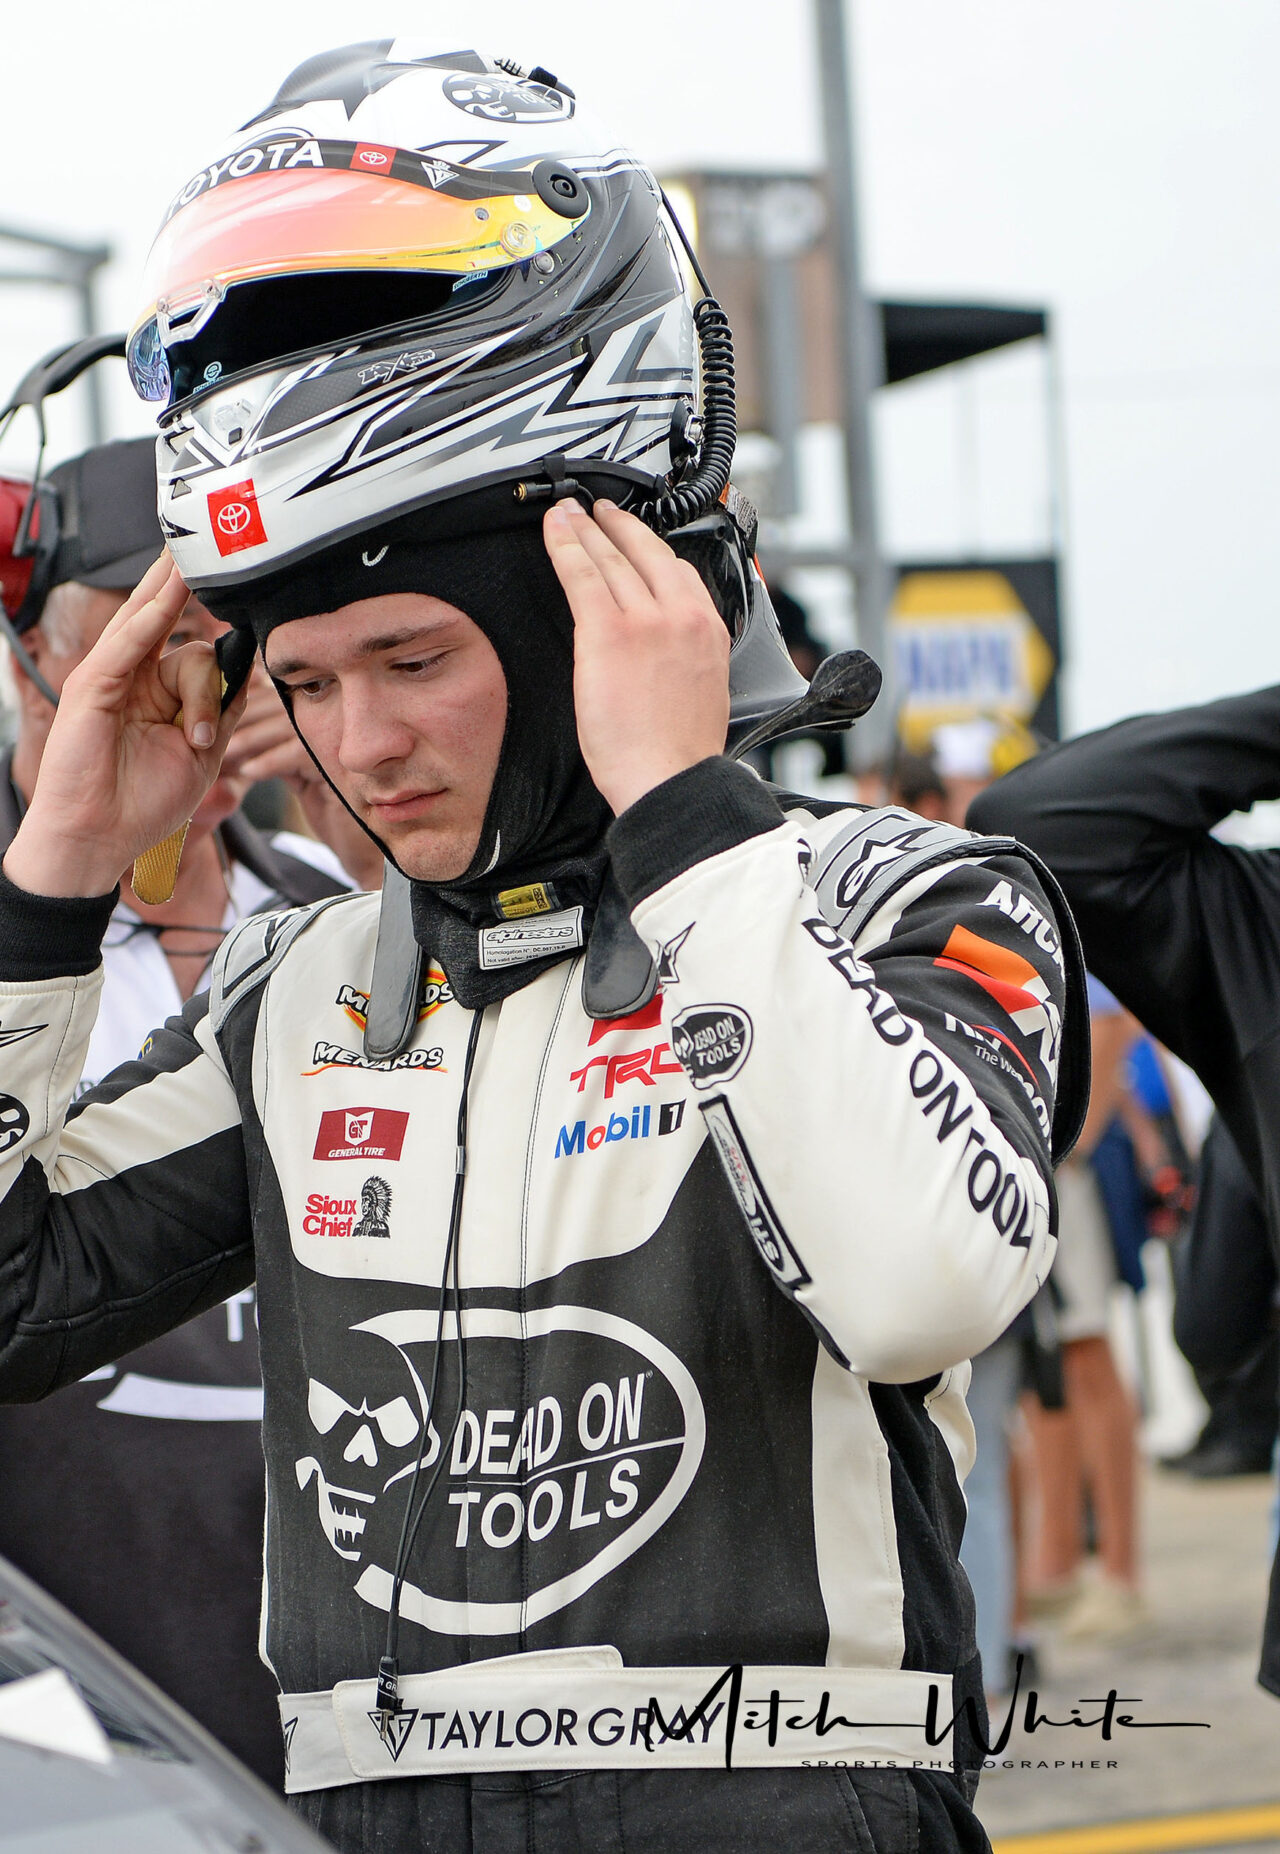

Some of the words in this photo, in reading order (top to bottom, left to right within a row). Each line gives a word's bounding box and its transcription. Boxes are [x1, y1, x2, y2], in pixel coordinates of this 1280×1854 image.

[486, 926, 573, 943] alpinestars
[693, 1026, 717, 1050] DEAD
[715, 1015, 736, 1040] ON
[696, 1037, 742, 1067] TOOLS
[910, 1049, 975, 1143] ON
[554, 1104, 651, 1160] Mobil
[328, 1147, 363, 1158] GENERAL
[363, 1146, 386, 1156] TIRE
[305, 1193, 357, 1215] Sioux
[302, 1214, 353, 1237] Chief
[449, 1395, 563, 1476] DEAD
[577, 1372, 646, 1451] ON
[447, 1458, 642, 1549] TOOLS
[420, 1707, 579, 1750] TAYLOR
[587, 1701, 726, 1747] GRAY
